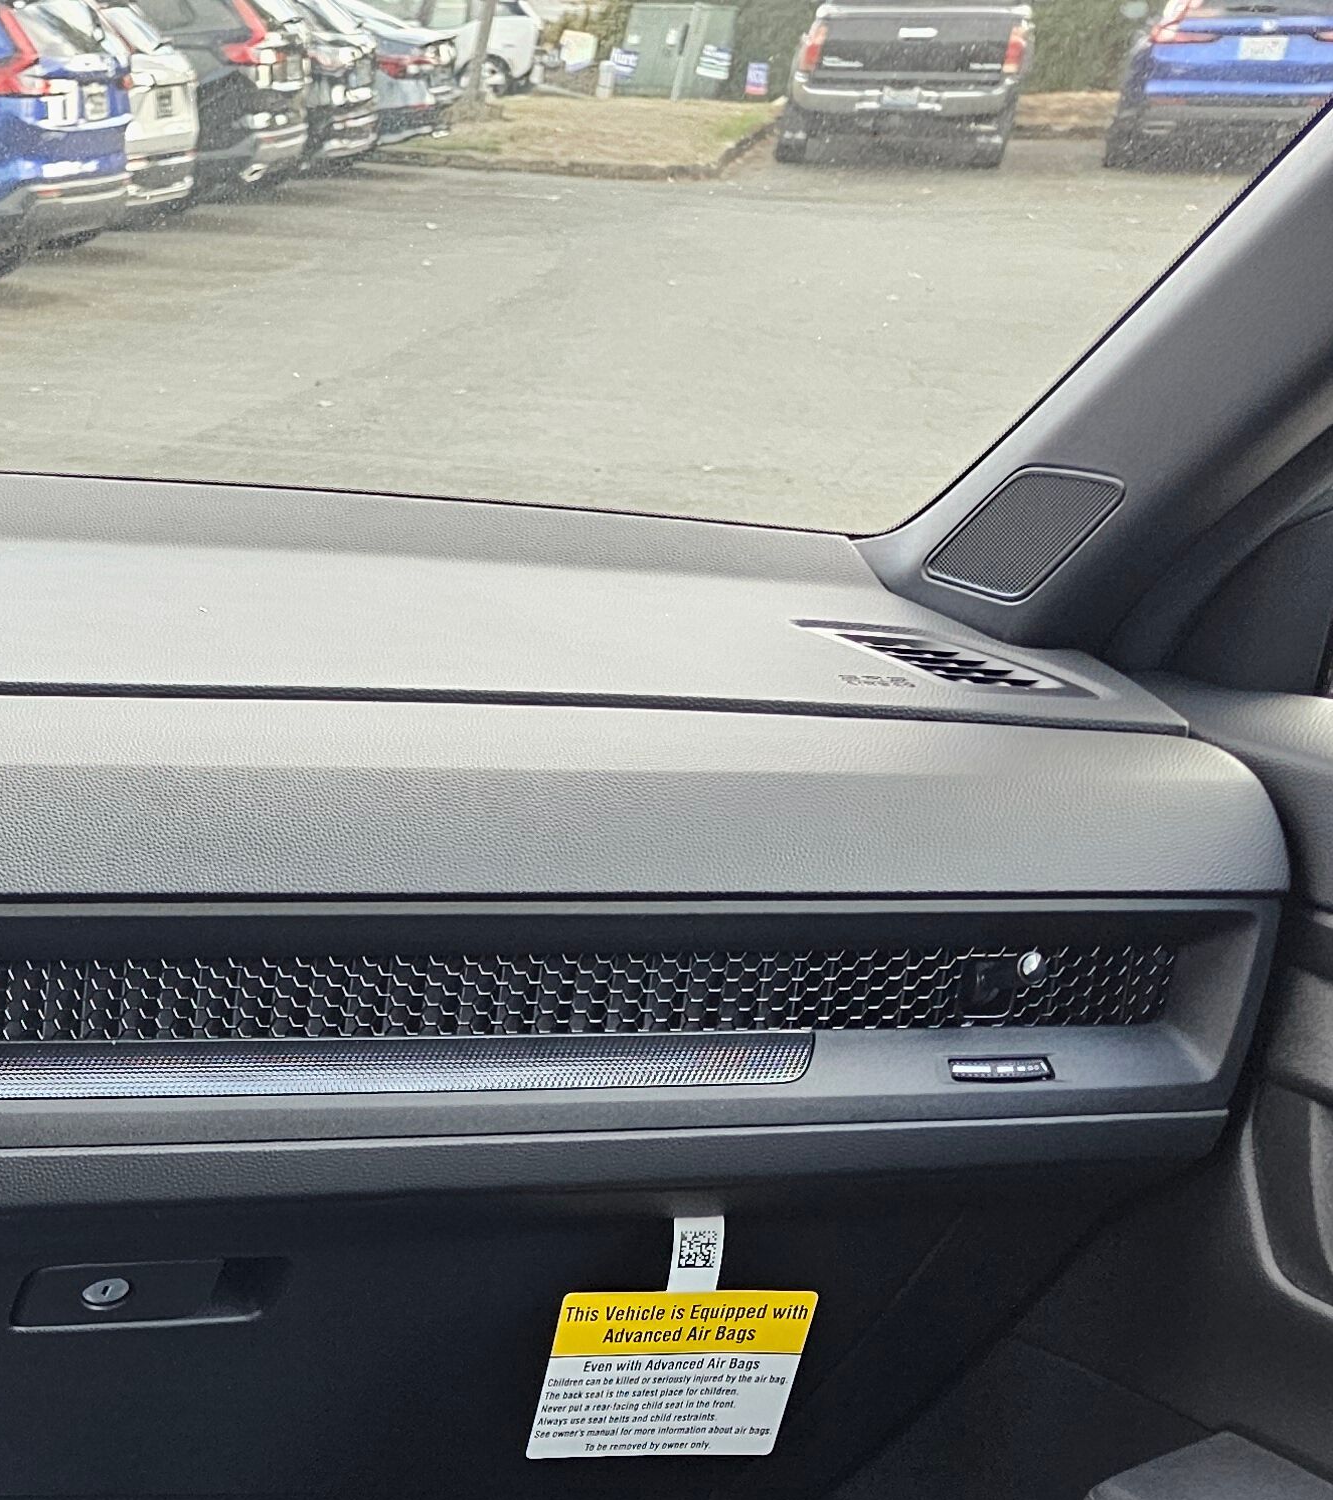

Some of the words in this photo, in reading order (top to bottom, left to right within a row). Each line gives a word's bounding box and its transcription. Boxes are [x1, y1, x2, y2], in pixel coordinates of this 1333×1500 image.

[566, 1307, 599, 1322] This
[606, 1305, 665, 1321] Vehicle
[671, 1305, 685, 1320] is
[690, 1304, 768, 1322] Equipped
[773, 1305, 809, 1320] with
[602, 1327, 683, 1343] Advanced
[686, 1326, 711, 1341] Air
[715, 1326, 756, 1343] Bags
[583, 1361, 613, 1372] Even
[617, 1360, 642, 1371] with
[645, 1358, 705, 1371] Advanced
[707, 1358, 726, 1369] Air
[729, 1358, 761, 1371] Bags
[547, 1378, 583, 1387] Children
[603, 1377, 613, 1385] be
[616, 1376, 640, 1385] killed
[651, 1375, 692, 1385] seriously
[692, 1374, 723, 1384] injured
[725, 1374, 736, 1384] by
[738, 1374, 752, 1383] the
[754, 1375, 768, 1383] air
[769, 1375, 789, 1385] bag.
[545, 1391, 560, 1400] The
[562, 1391, 582, 1399] back
[606, 1390, 614, 1398] is
[616, 1389, 630, 1398] the
[632, 1389, 658, 1397] safest
[659, 1388, 683, 1399] place
[686, 1387, 698, 1396] for
[699, 1387, 739, 1396] children.
[541, 1404, 566, 1413] Never
[592, 1402, 639, 1412] rear-facing
[641, 1401, 663, 1410] child
[665, 1400, 684, 1409] seat
[685, 1400, 693, 1408] in
[696, 1400, 710, 1408] the
[537, 1417, 568, 1426] Always
[570, 1417, 586, 1425] use
[608, 1415, 630, 1424] belts
[632, 1415, 648, 1423] and
[650, 1414, 672, 1422] child
[534, 1430, 550, 1439] See
[552, 1429, 584, 1438] owner's
[586, 1427, 619, 1437] manual
[620, 1427, 632, 1436] for
[658, 1426, 707, 1435] information
[708, 1426, 733, 1434] about
[734, 1426, 747, 1435] air
[749, 1426, 772, 1436] bags.
[585, 1443, 594, 1451] To
[596, 1443, 607, 1451] be
[609, 1442, 647, 1450] removed
[649, 1442, 660, 1451] by
[661, 1441, 689, 1449] owner
[690, 1441, 711, 1450] only.
